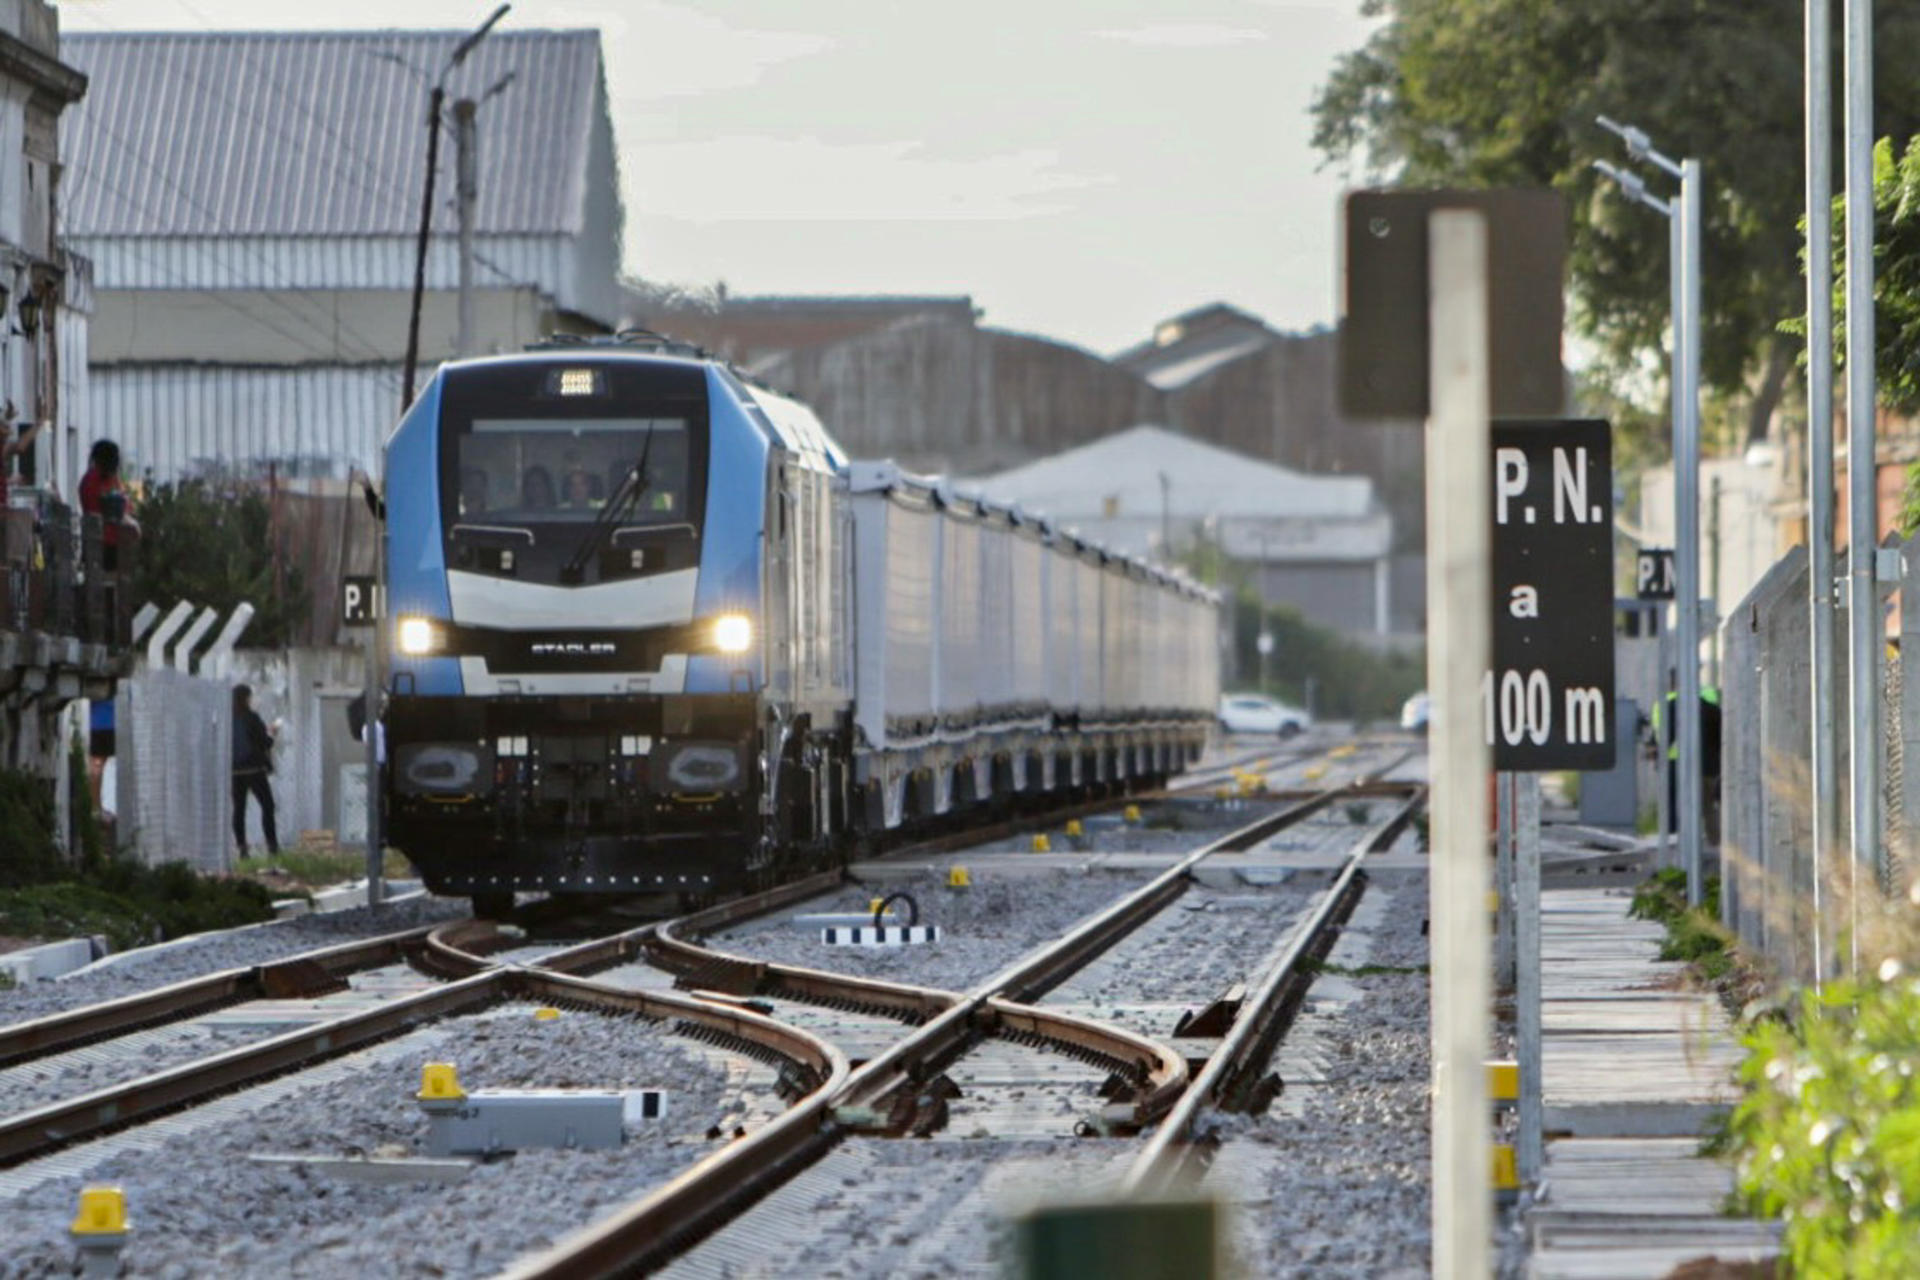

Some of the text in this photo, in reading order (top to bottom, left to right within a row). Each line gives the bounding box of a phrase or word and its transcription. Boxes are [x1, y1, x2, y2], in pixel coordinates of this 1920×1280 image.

[1496, 447, 1602, 524] P. N.
[344, 584, 364, 619] P.
[1509, 584, 1539, 618] a
[531, 643, 616, 654] STADLER
[1483, 668, 1605, 747] 100 m
